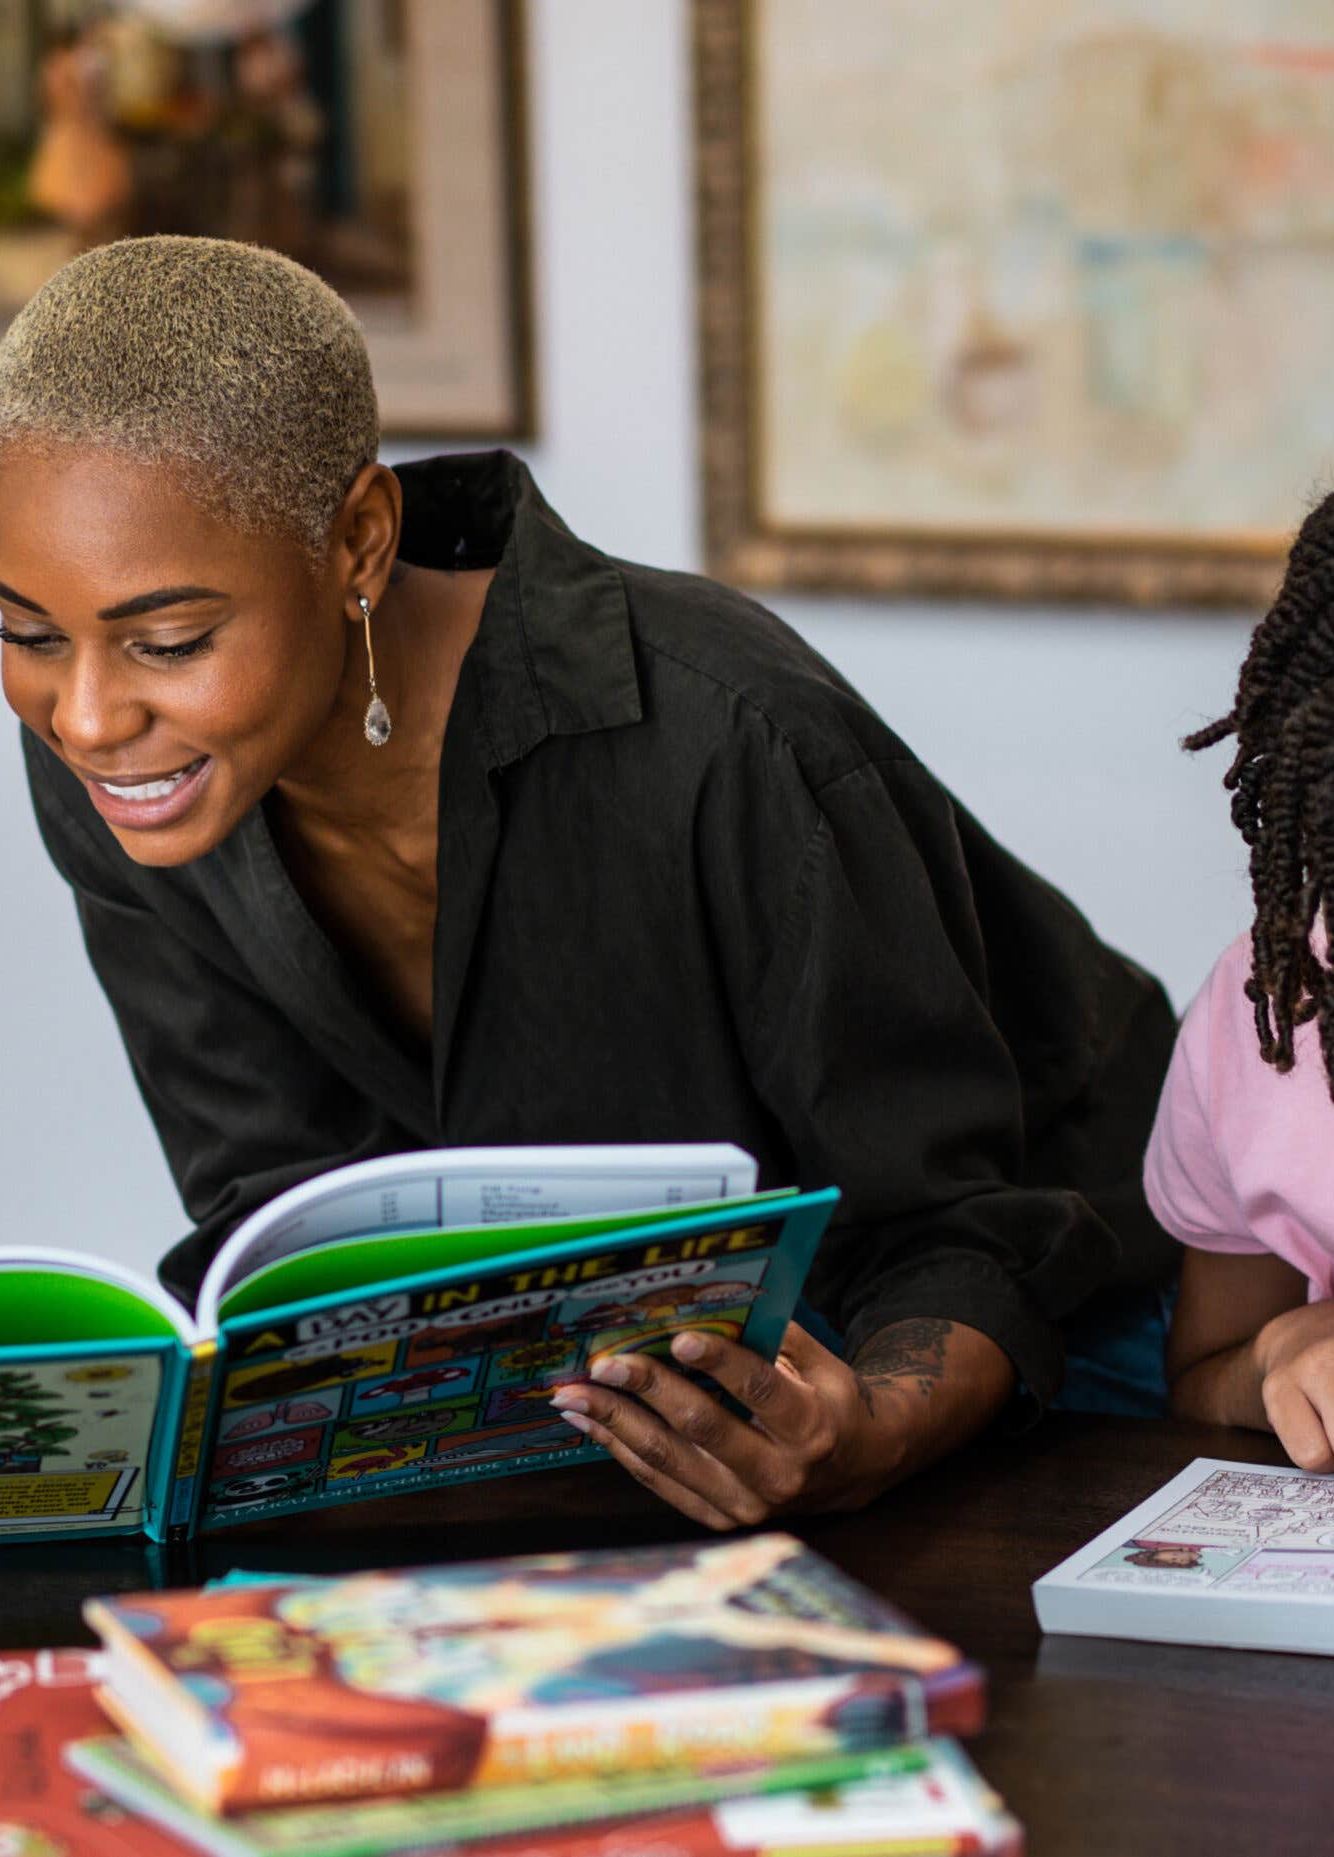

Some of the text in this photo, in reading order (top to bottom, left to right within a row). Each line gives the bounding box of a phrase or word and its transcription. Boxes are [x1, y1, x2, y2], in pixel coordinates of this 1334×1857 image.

[243, 1223, 768, 1355] A DAY IN THE LIFE
[333, 1320, 420, 1350] POO
[459, 1293, 556, 1322] GNU
[622, 1262, 706, 1288] YOU
